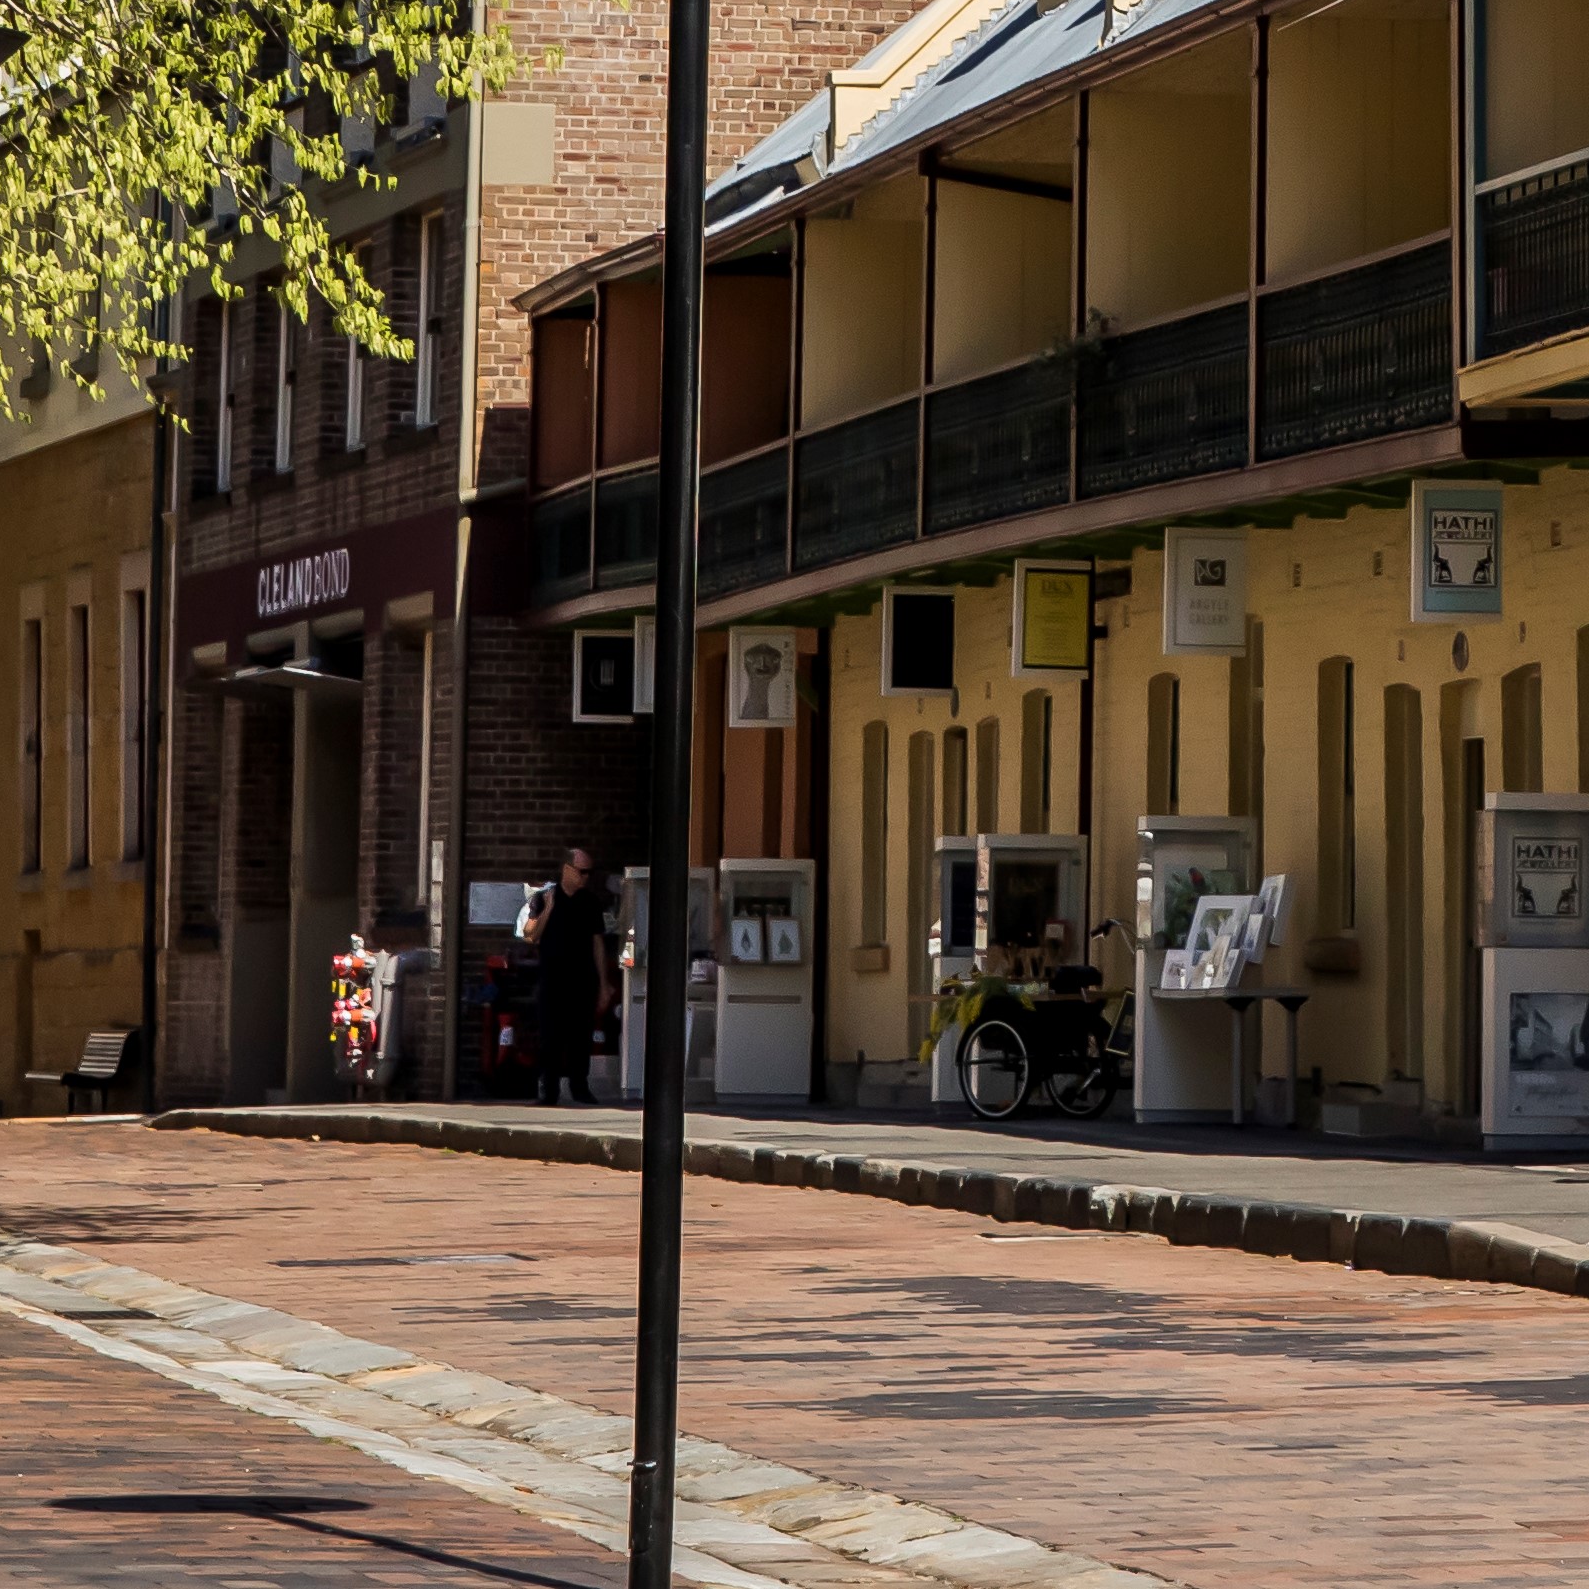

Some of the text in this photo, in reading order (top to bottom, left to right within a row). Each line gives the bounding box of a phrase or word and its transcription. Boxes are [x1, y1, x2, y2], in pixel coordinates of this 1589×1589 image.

[1434, 515, 1493, 530] HATHI
[257, 548, 350, 619] CLELAND BOND
[1517, 844, 1578, 859] HATHI
